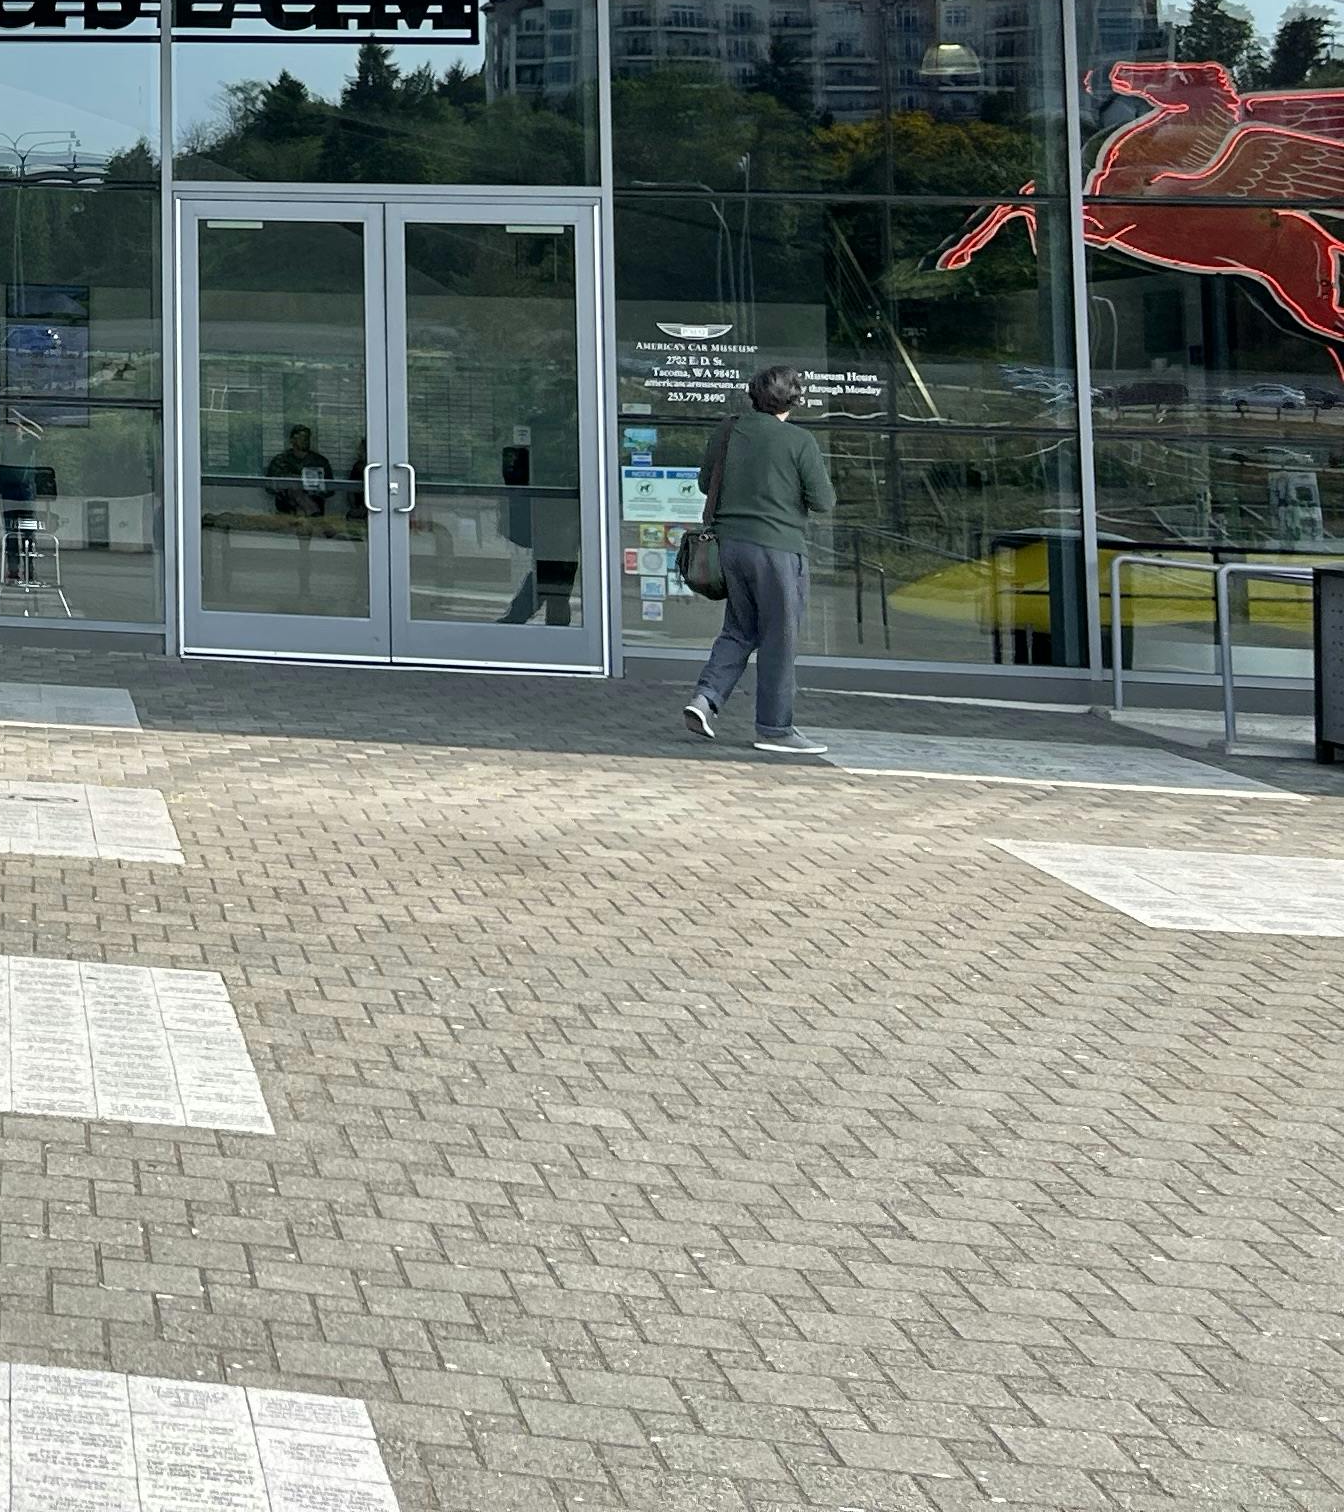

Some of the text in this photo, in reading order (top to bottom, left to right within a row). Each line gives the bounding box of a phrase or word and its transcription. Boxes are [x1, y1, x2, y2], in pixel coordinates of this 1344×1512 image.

[635, 341, 686, 351] AMERICA'S
[687, 343, 708, 352] CAR
[665, 355, 687, 365] 2702
[651, 367, 740, 379] Tacoma, WA 98421
[804, 371, 845, 381] Museum
[846, 372, 878, 382] Hours
[808, 384, 844, 395] through
[845, 385, 882, 396] Monday
[807, 398, 823, 408] pm
